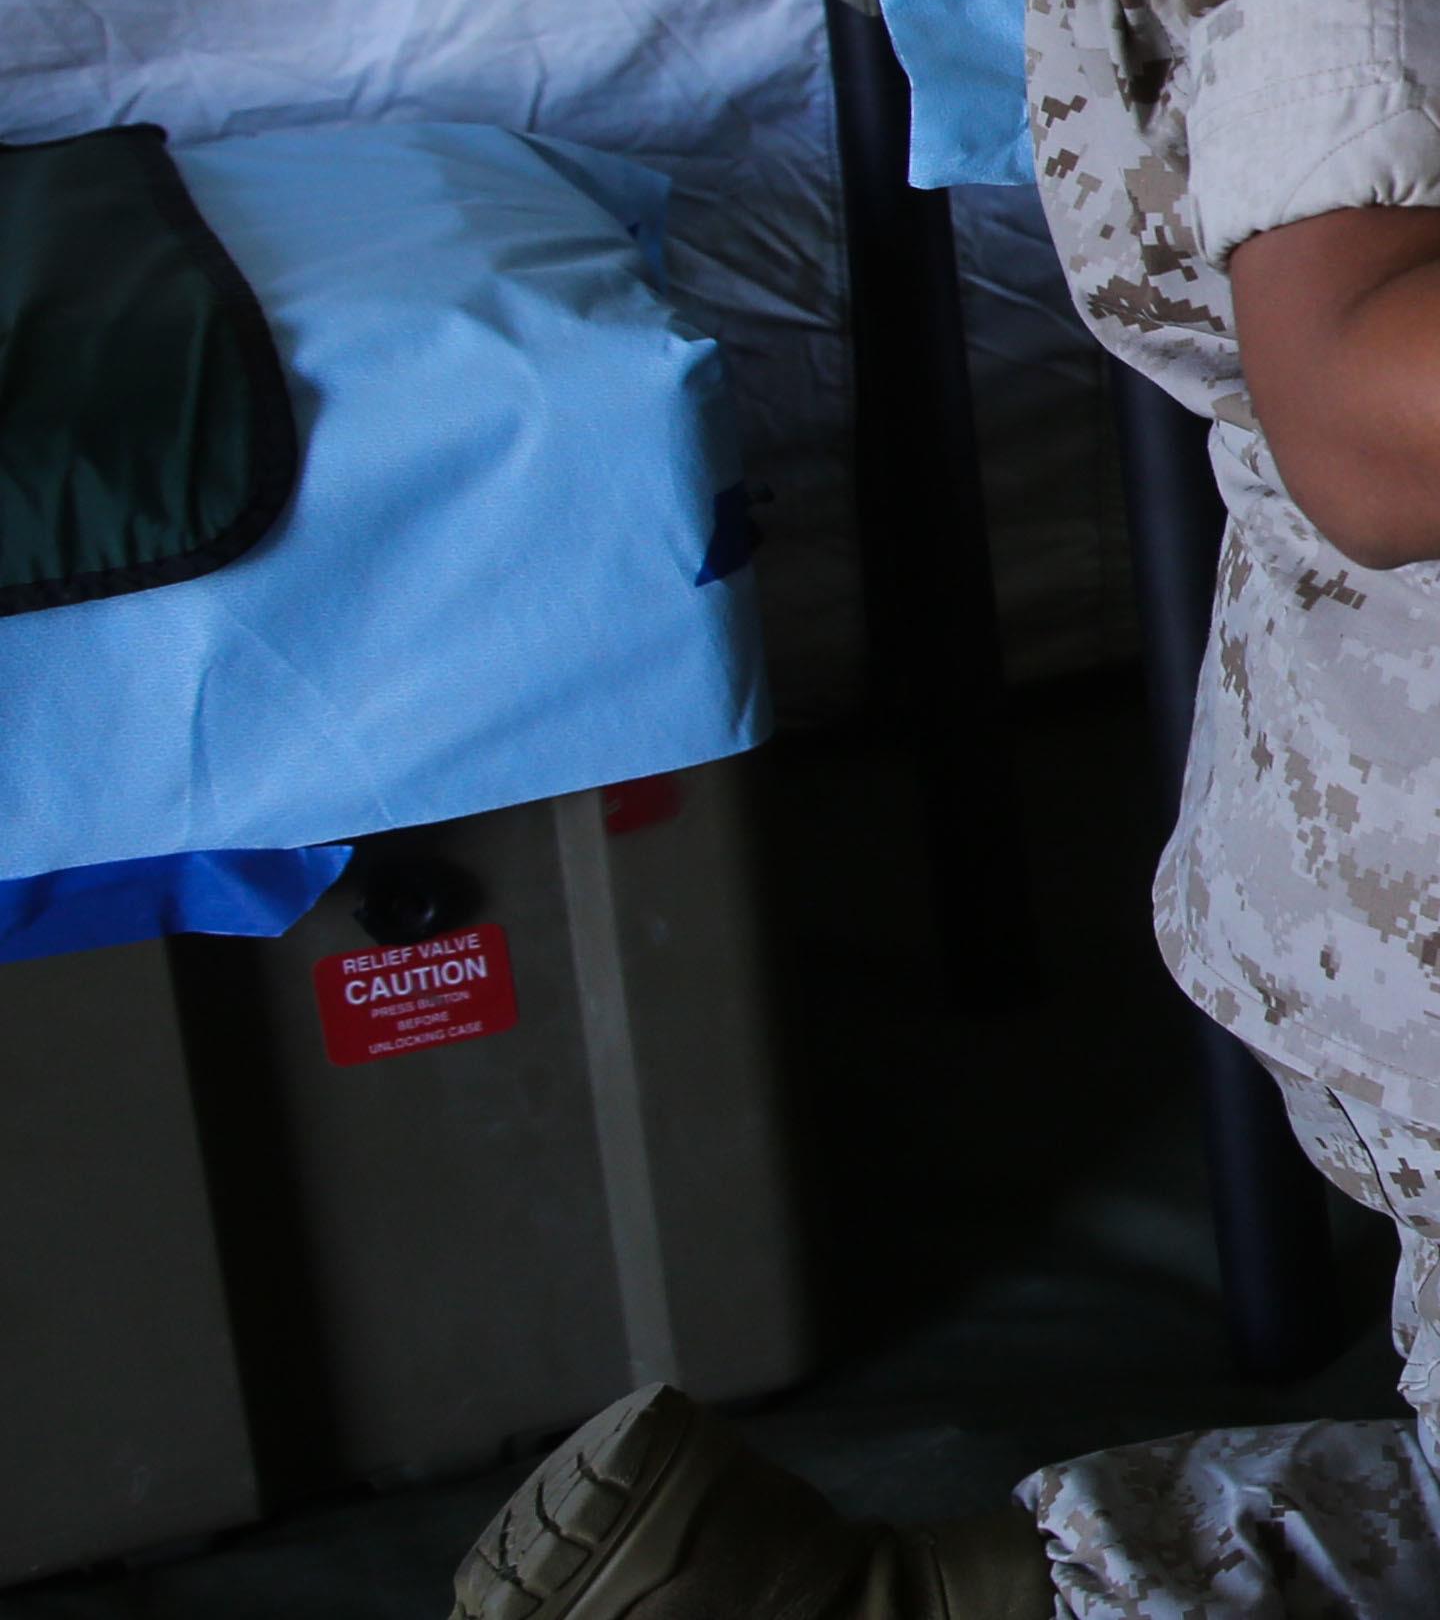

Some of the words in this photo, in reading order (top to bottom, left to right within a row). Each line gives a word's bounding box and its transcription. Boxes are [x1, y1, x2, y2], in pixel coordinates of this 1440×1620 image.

[342, 946, 413, 975] RELIEF
[416, 933, 481, 959] VALVE
[344, 955, 488, 1005] CAUTION
[371, 1001, 415, 1018] PRESS
[417, 990, 471, 1010] BUTTON
[397, 1011, 449, 1031] BEFORE
[368, 1030, 446, 1054] UNLOCKING
[448, 1020, 484, 1037] CASE
